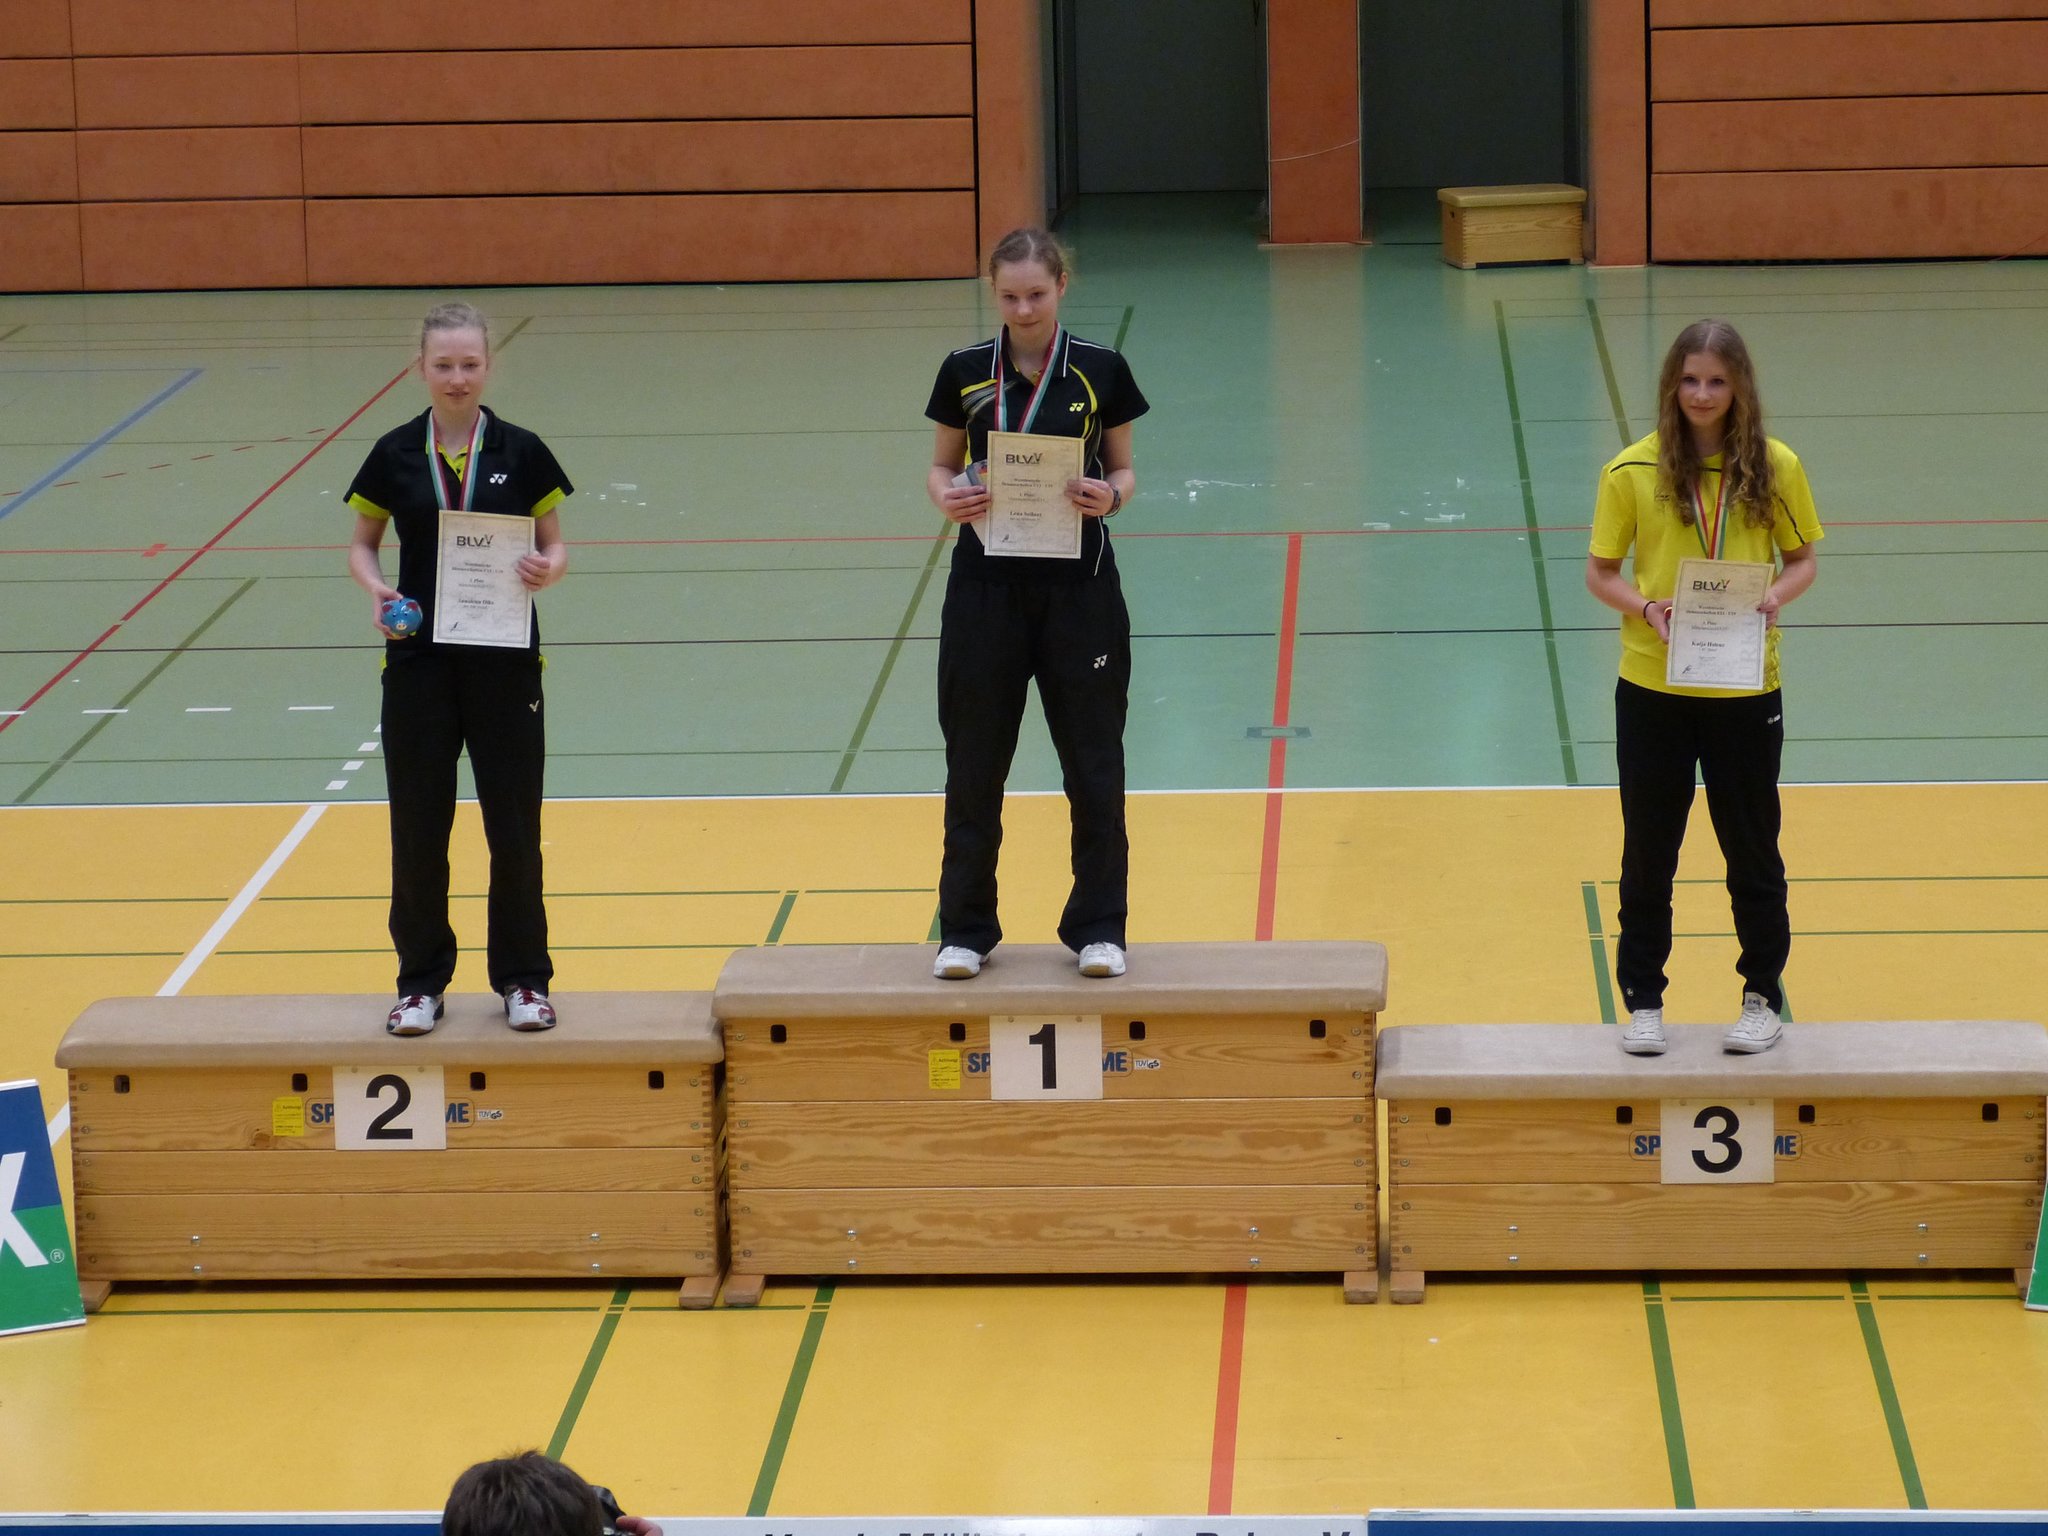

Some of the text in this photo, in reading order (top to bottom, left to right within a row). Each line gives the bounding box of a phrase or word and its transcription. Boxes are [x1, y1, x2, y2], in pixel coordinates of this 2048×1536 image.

[1029, 1023, 1057, 1089] 1
[365, 1074, 413, 1140] 2
[1691, 1105, 1743, 1174] 3
